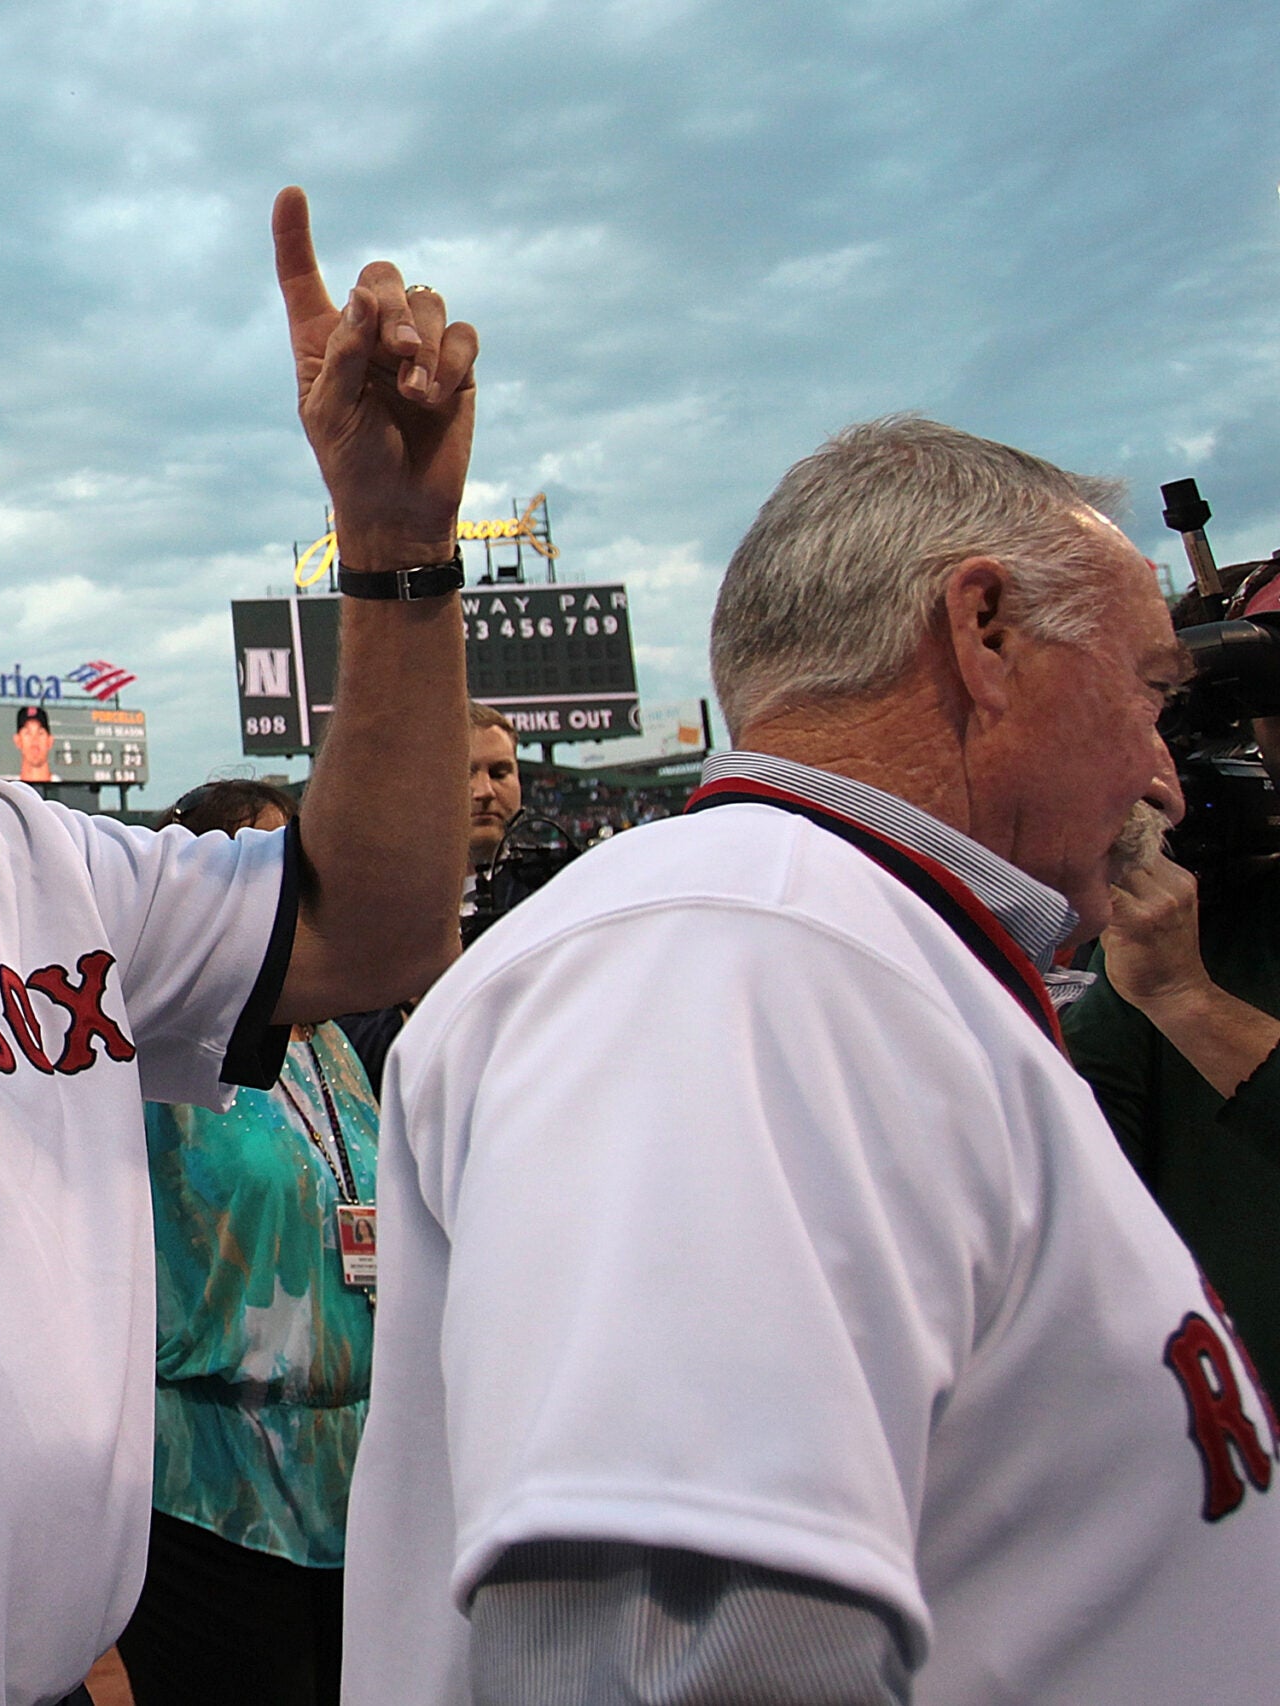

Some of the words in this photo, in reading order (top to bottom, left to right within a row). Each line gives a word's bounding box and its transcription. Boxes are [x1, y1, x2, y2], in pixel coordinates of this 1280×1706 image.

[457, 493, 560, 559] ncock
[238, 647, 291, 698] N
[505, 710, 561, 731] TRIKE
[568, 709, 612, 730] OUT
